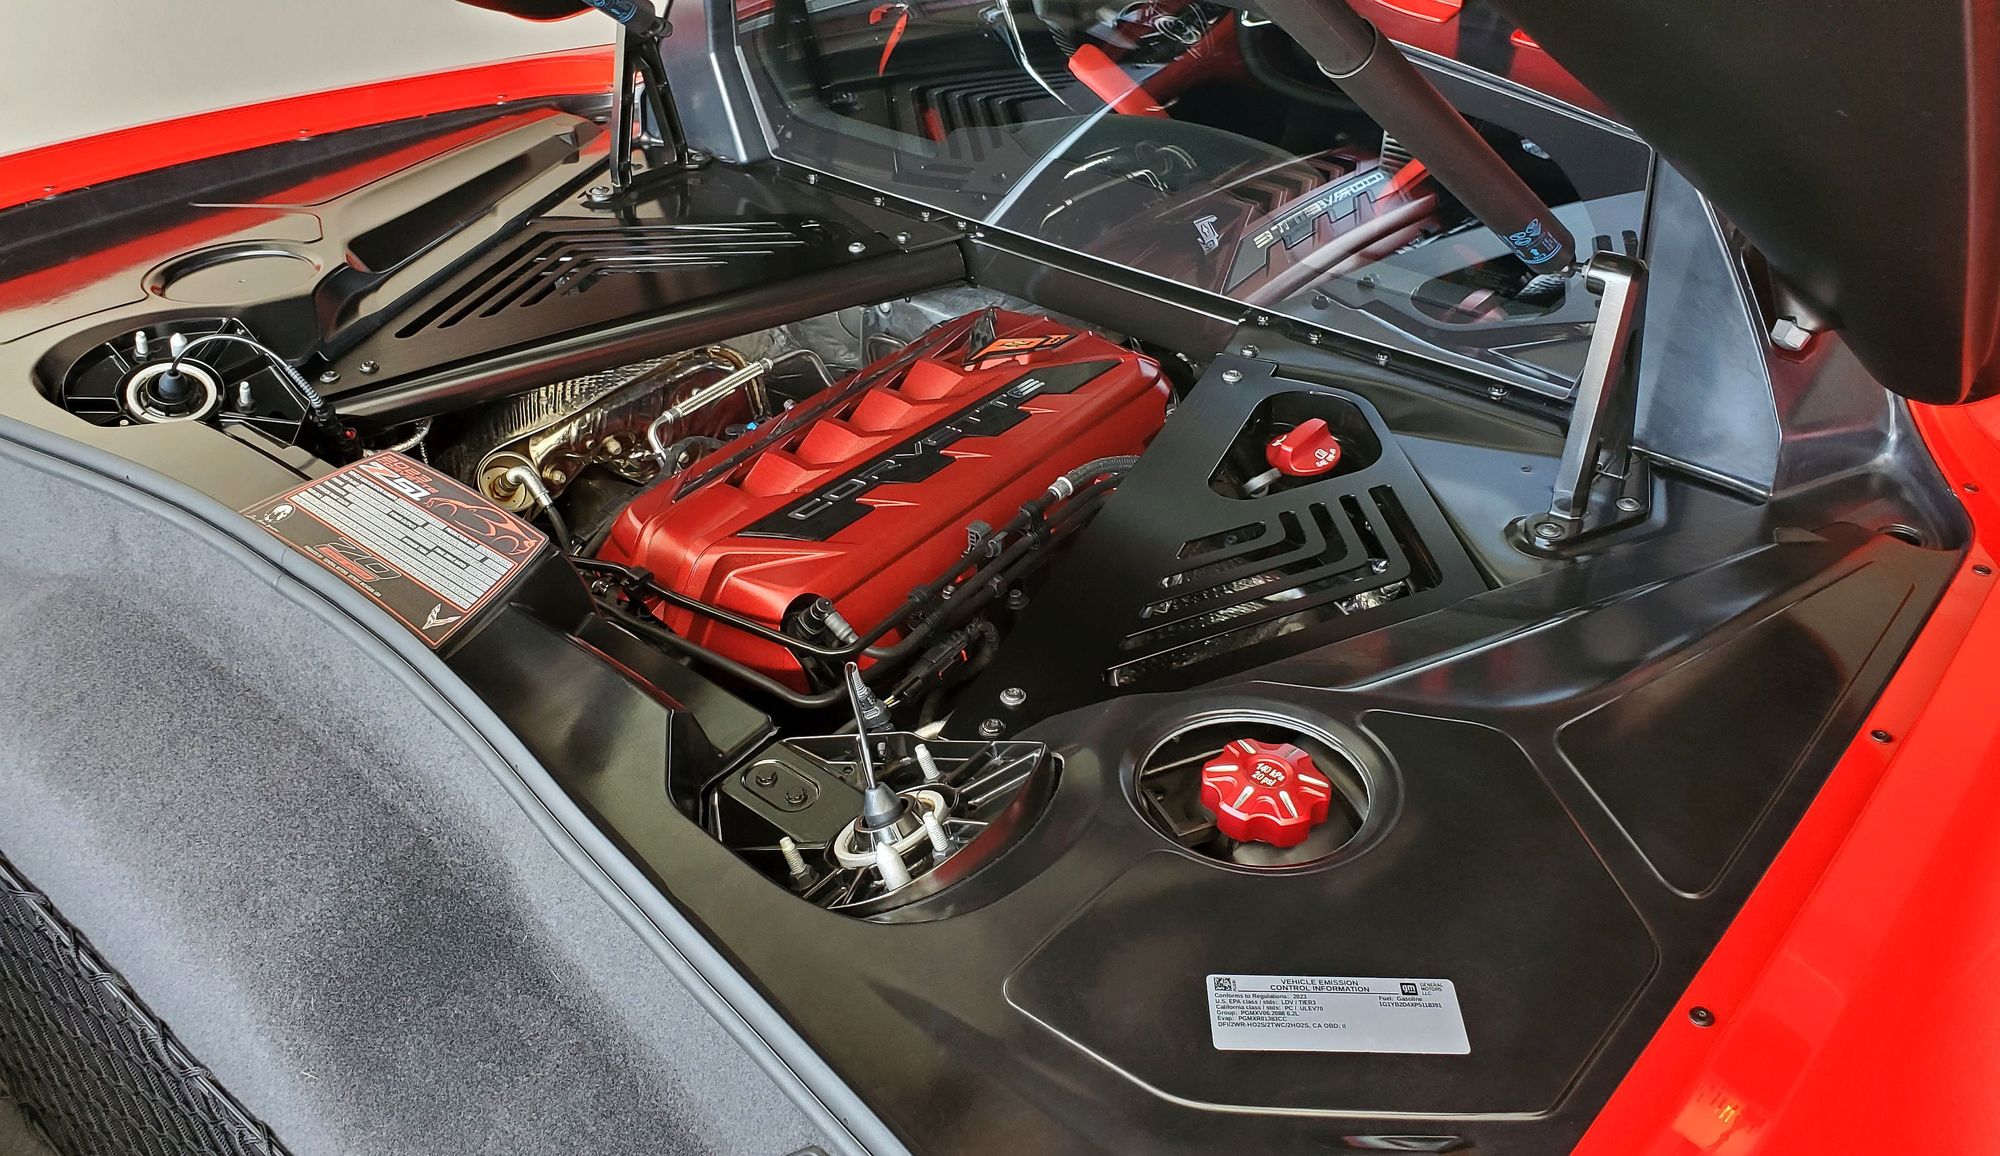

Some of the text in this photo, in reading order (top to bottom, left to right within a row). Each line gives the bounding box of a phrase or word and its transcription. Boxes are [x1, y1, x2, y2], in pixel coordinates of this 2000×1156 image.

[788, 378, 1045, 520] CORVETTE
[1251, 771, 1277, 787] 20 psi
[1256, 763, 1285, 782] 140 kPa
